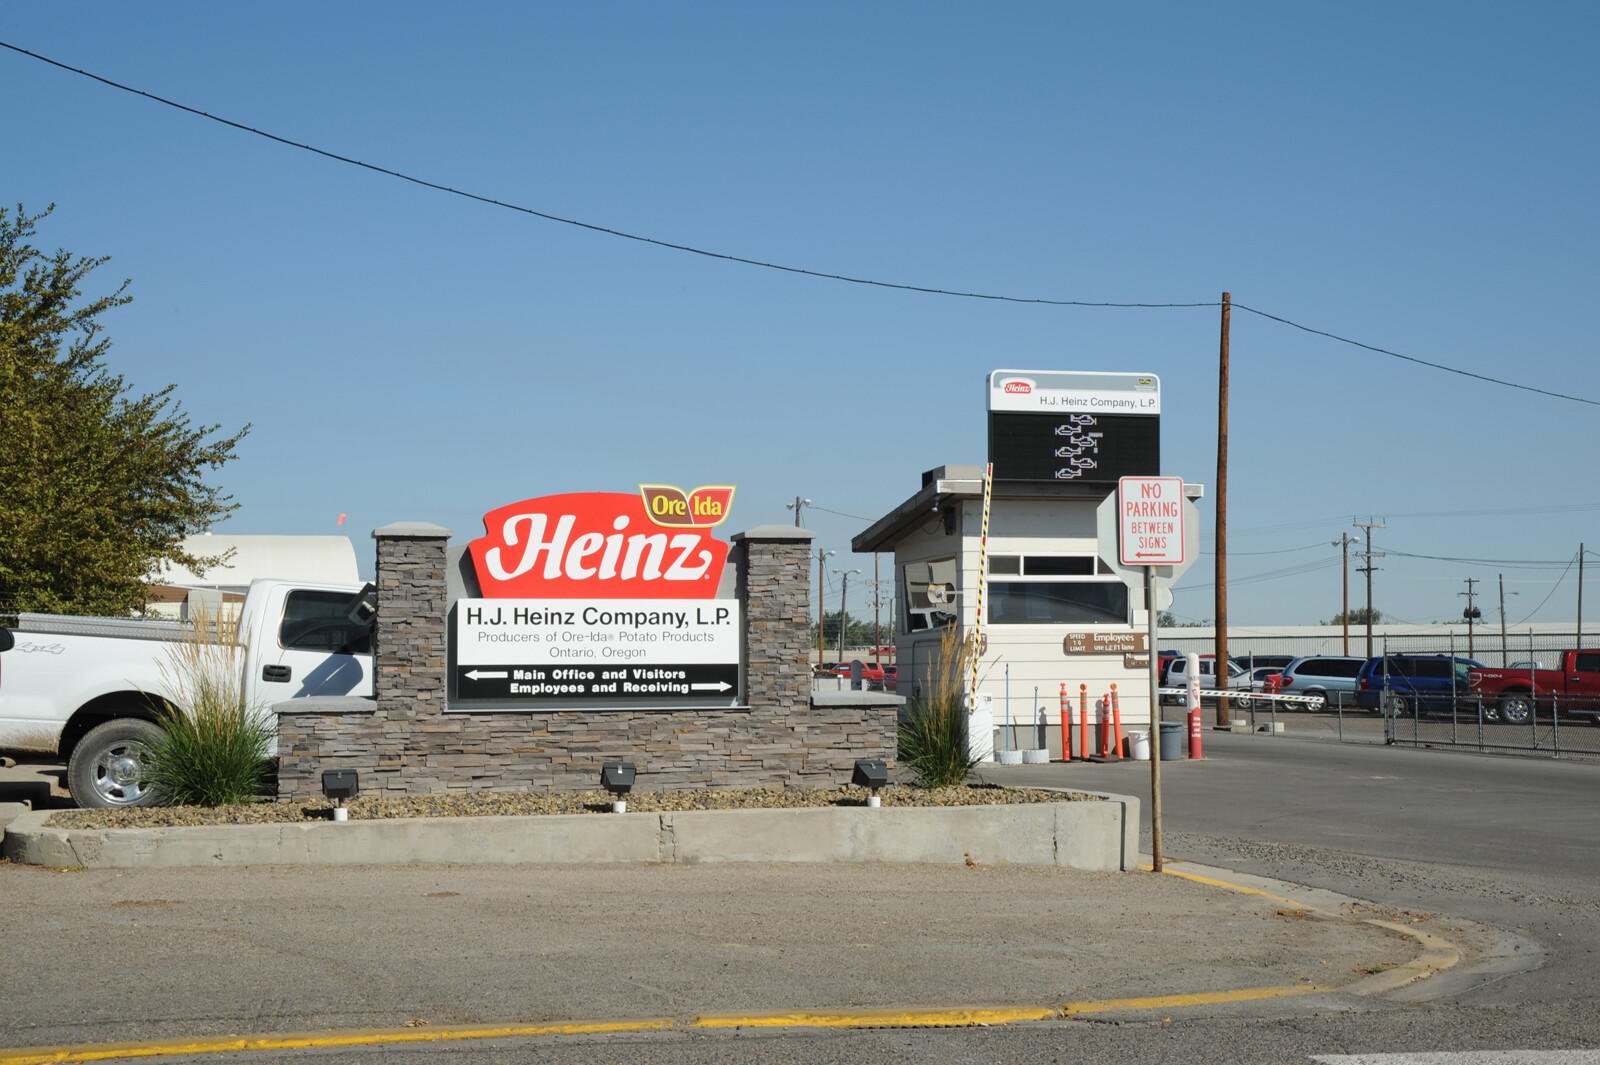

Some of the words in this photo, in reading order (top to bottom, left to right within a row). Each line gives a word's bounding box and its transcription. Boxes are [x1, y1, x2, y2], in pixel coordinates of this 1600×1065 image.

[1005, 383, 1030, 392] Heinz
[1040, 396, 1058, 406] H.J.
[1061, 397, 1087, 406] Heinz
[1090, 397, 1137, 409] Company,
[1140, 399, 1156, 408] L.P.
[1141, 483, 1161, 499] NO
[652, 495, 686, 515] Ore
[694, 496, 722, 516] Ida
[1126, 501, 1178, 517] PARKING
[1131, 522, 1174, 534] BETWEEN
[485, 513, 713, 580] Heinz
[1139, 536, 1167, 549] SIGNS
[467, 607, 507, 625] H.J.
[514, 607, 575, 625] Heinz
[582, 607, 689, 629] Company,
[696, 607, 731, 625] L.P.
[478, 631, 540, 642] Producers
[545, 631, 557, 642] of
[619, 631, 657, 642] Potato
[662, 631, 715, 642] Products
[1093, 633, 1135, 644] Employees
[549, 647, 597, 659] Ontario,
[602, 646, 646, 659] Oregon
[1121, 643, 1135, 651] lane
[513, 670, 545, 680] Main
[552, 669, 595, 680] Office
[602, 669, 627, 680] and
[633, 669, 686, 679] Visitors
[510, 683, 585, 695] Employees
[591, 682, 617, 693] and
[623, 682, 689, 694] Receiving
